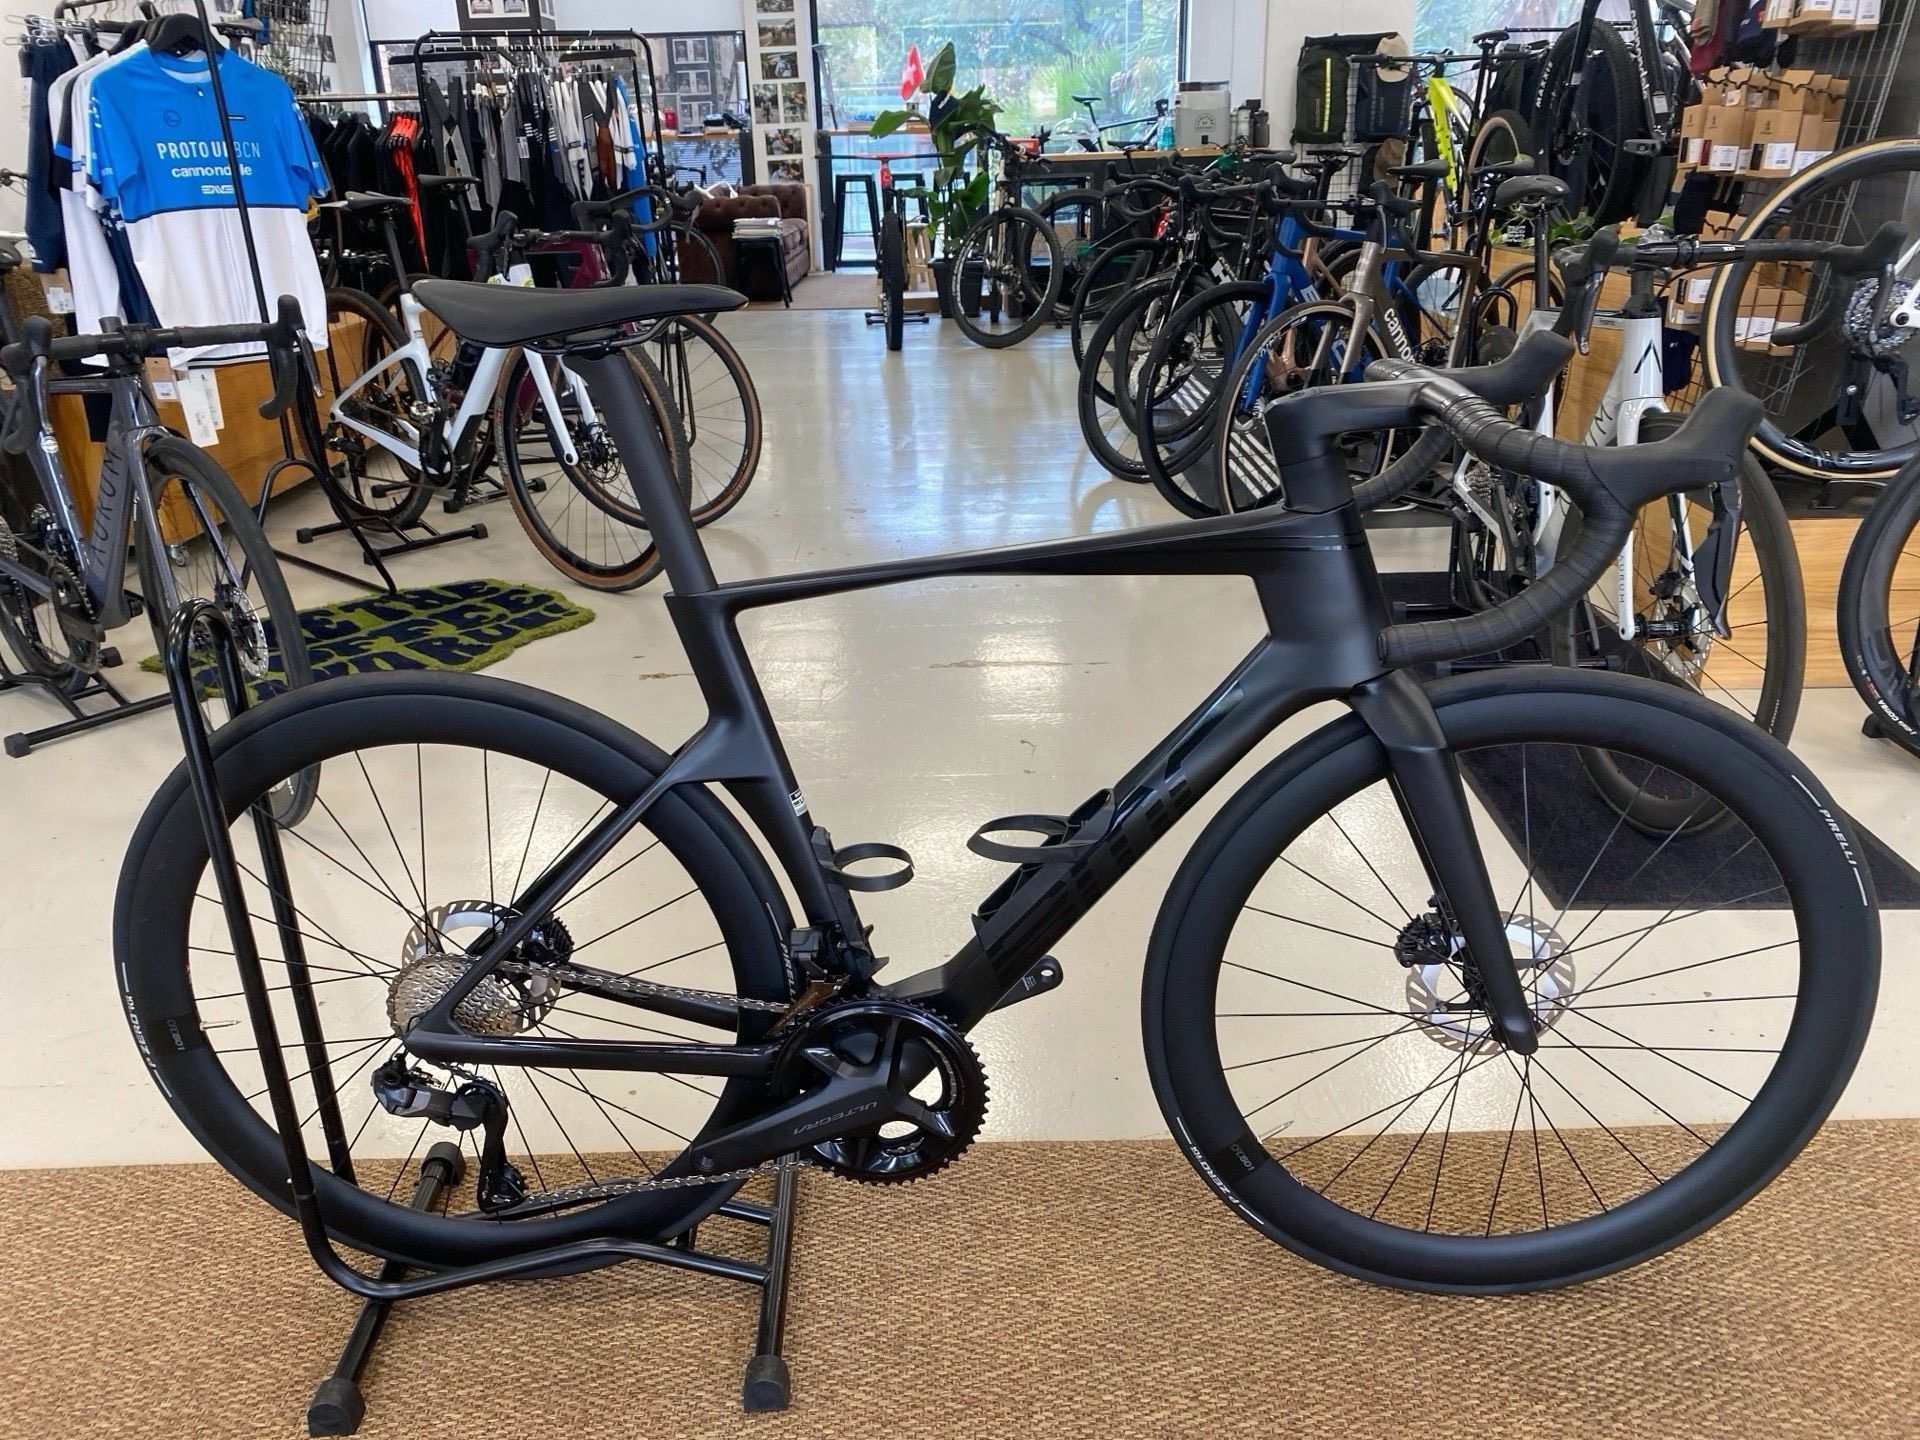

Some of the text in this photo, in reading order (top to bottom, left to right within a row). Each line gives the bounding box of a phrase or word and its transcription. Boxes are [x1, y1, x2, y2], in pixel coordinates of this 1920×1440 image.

[171, 163, 253, 178] cannondle
[1819, 809, 1857, 865] PIRELLI
[129, 1013, 151, 1055] ZERO
[793, 1101, 878, 1135] ULTEGRA
[1200, 1161, 1231, 1194] ZERO
